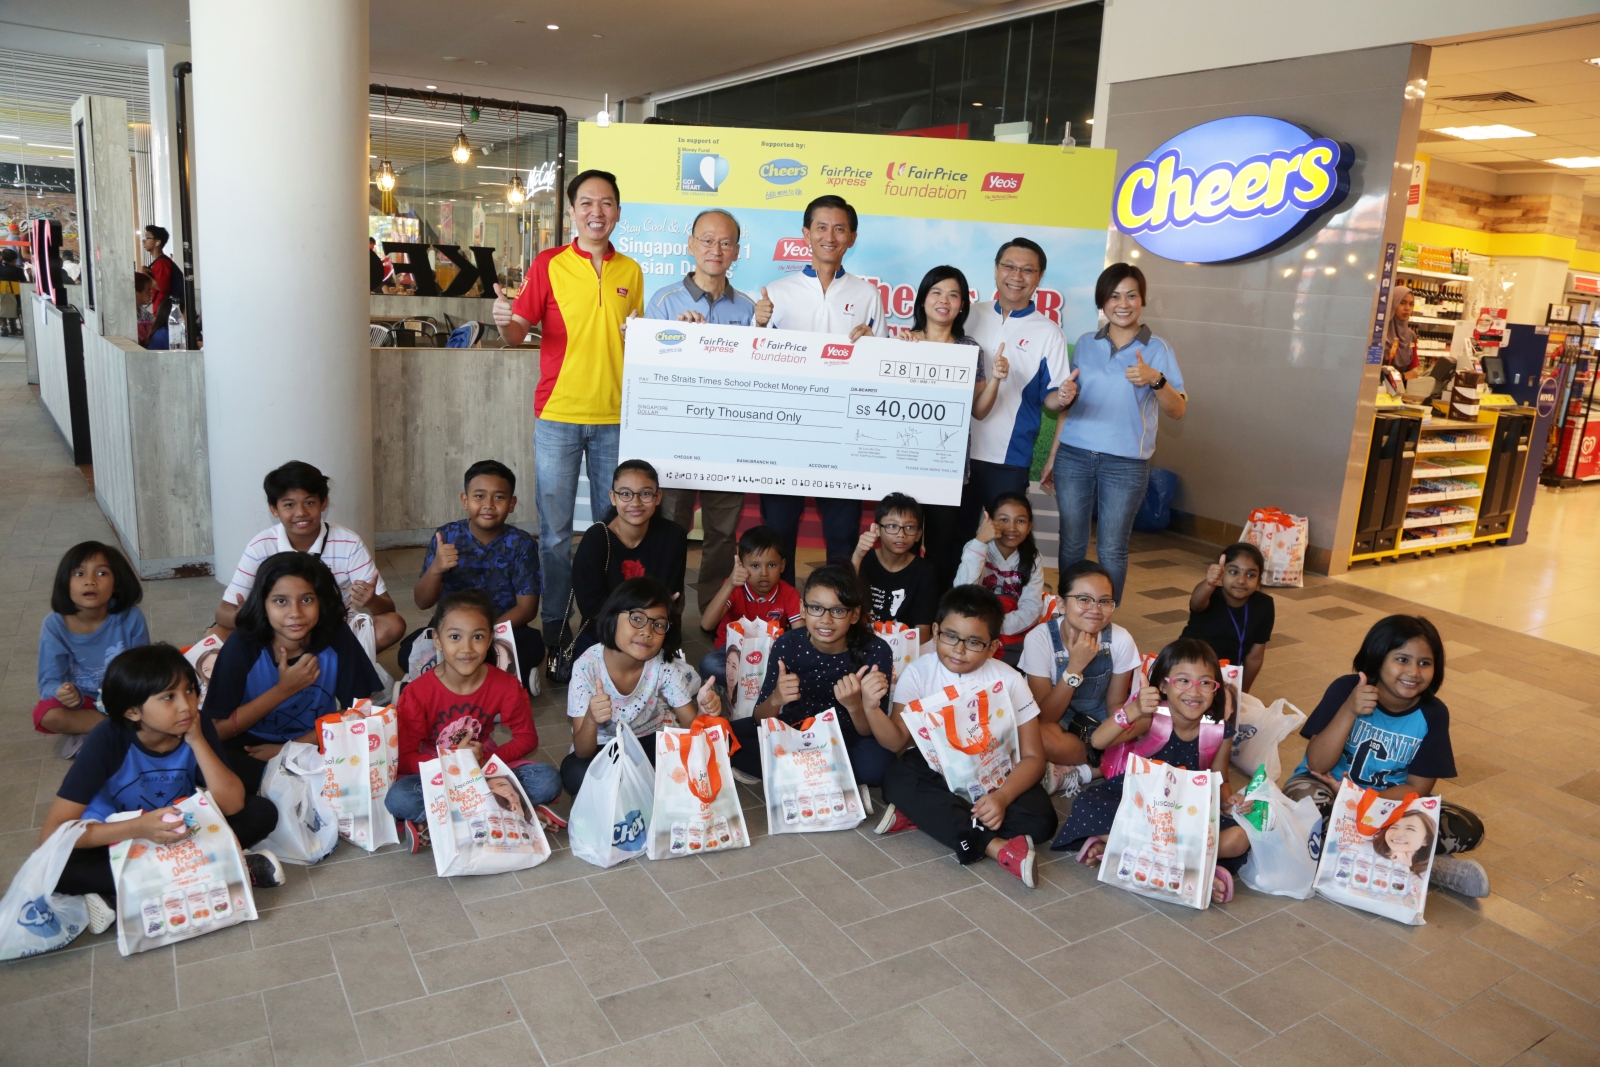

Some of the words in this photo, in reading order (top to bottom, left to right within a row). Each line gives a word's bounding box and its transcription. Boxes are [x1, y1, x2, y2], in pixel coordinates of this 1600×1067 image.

[759, 163, 808, 179] Cheers
[820, 165, 873, 179] FairPrice
[908, 165, 968, 182] FairPrice
[826, 176, 867, 187] xpress
[989, 174, 1018, 189] Yeo's
[1114, 145, 1336, 231] Cheers
[884, 181, 967, 200] foundation
[619, 220, 641, 236] Stay
[643, 218, 667, 232] Cool
[619, 237, 688, 258] Singapor
[639, 259, 675, 276] sian
[655, 331, 686, 341] Cheers
[699, 336, 739, 348] FairPrice
[703, 345, 734, 353] xpress
[766, 340, 808, 352] FairPrice
[827, 346, 849, 357] Yeo's
[751, 350, 807, 364] foundation
[654, 373, 669, 382] The
[671, 374, 696, 384] Straits
[698, 376, 722, 386] Times
[724, 378, 751, 388] School
[753, 381, 780, 390] Pocket
[781, 383, 808, 393] Money
[810, 385, 830, 393] Fund
[1540, 394, 1554, 402] NIVEA
[686, 405, 715, 419] Forty
[718, 407, 773, 421] Thousand
[777, 411, 802, 425] Only
[856, 404, 871, 416] S$
[875, 399, 946, 421] 40,000
[1152, 797, 1176, 808] juscool
